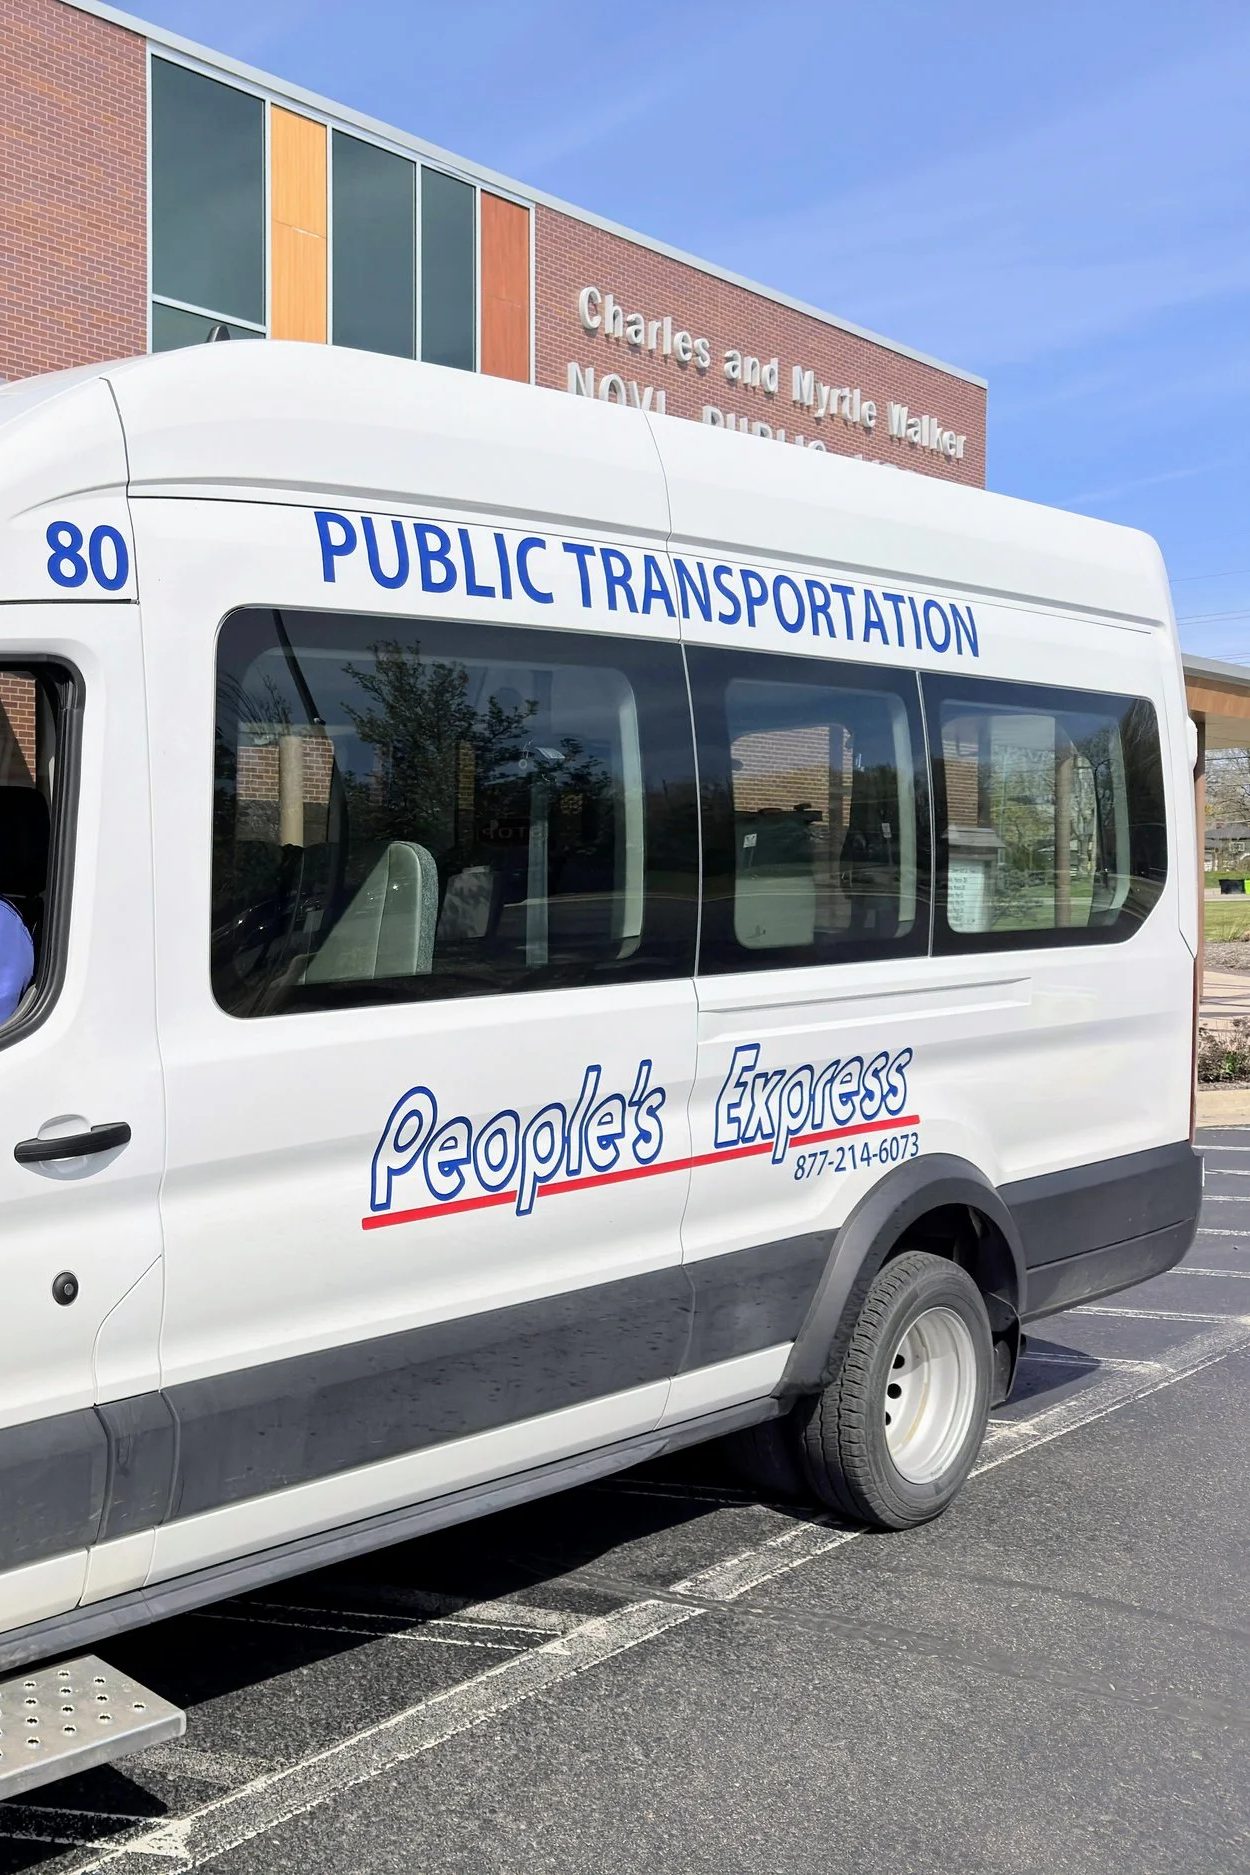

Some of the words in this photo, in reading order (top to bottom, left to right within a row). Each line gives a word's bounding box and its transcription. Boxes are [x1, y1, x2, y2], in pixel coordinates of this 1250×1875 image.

[578, 286, 710, 369] Charles
[723, 349, 779, 394] and
[792, 365, 877, 428] Myrtle
[886, 400, 967, 459] Walker
[46, 520, 129, 591] 80
[314, 511, 554, 604] PUBLIC
[563, 543, 980, 658] TRANSPORTATION
[370, 1058, 666, 1216] People's
[714, 1042, 913, 1165] Express
[794, 1132, 920, 1181] 877-214-6073
